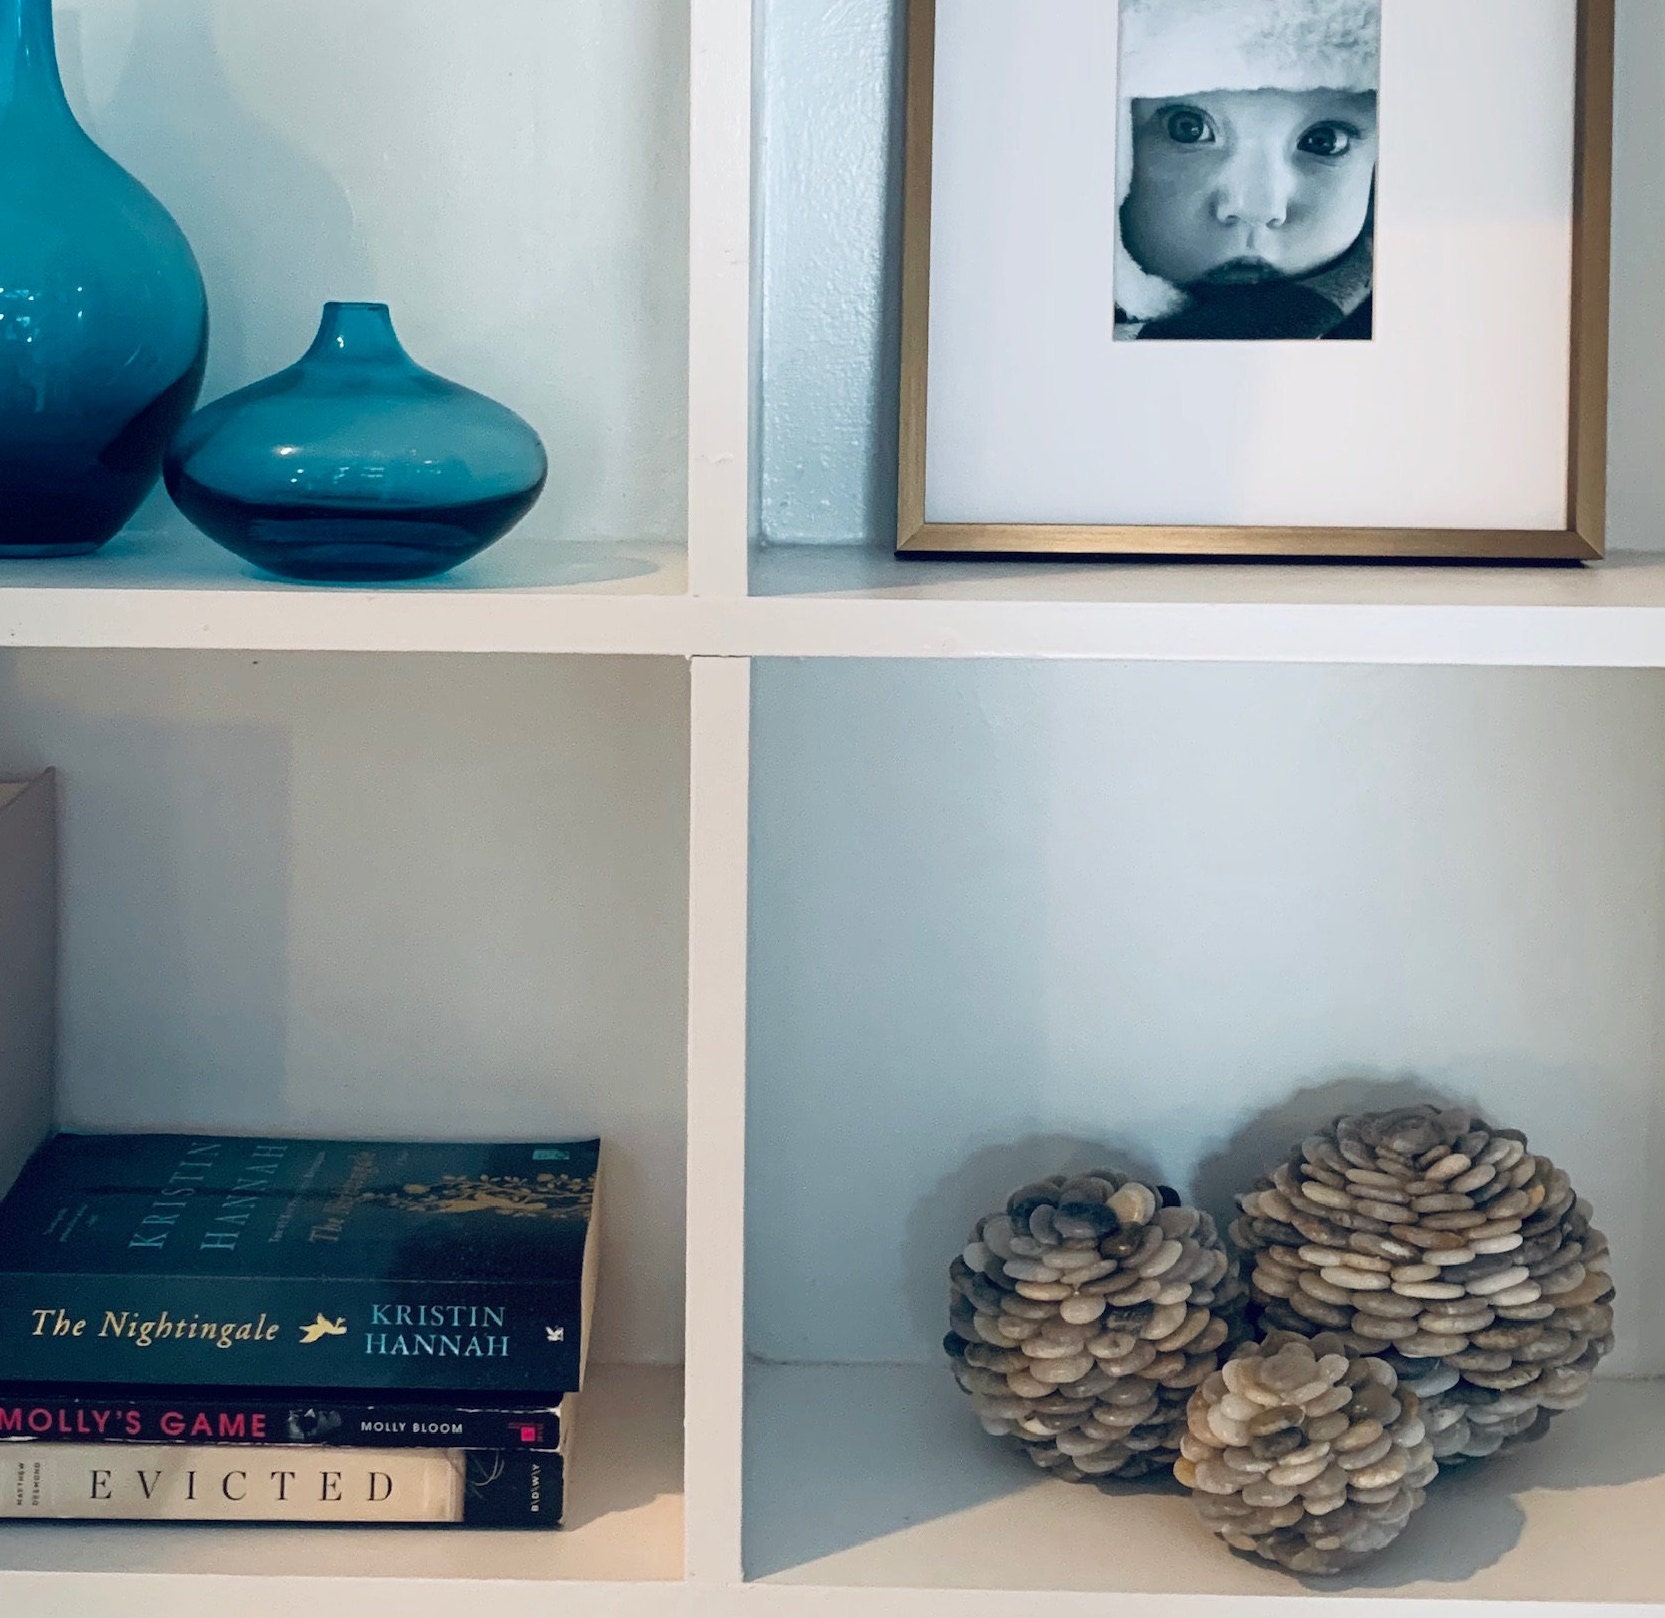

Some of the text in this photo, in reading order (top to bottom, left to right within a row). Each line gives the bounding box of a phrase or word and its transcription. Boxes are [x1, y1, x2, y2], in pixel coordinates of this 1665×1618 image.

[128, 1142, 222, 1249] KRISTIN
[199, 1145, 289, 1251] HANNAH
[31, 1308, 281, 1349] The Nightingale
[370, 1303, 506, 1328] KRISTIN
[364, 1332, 511, 1357] HANNAH
[0, 1407, 267, 1438] MOLLY'S GAME
[360, 1421, 463, 1434] MOLLY BLOOM
[88, 1469, 394, 1501] EVICTED
